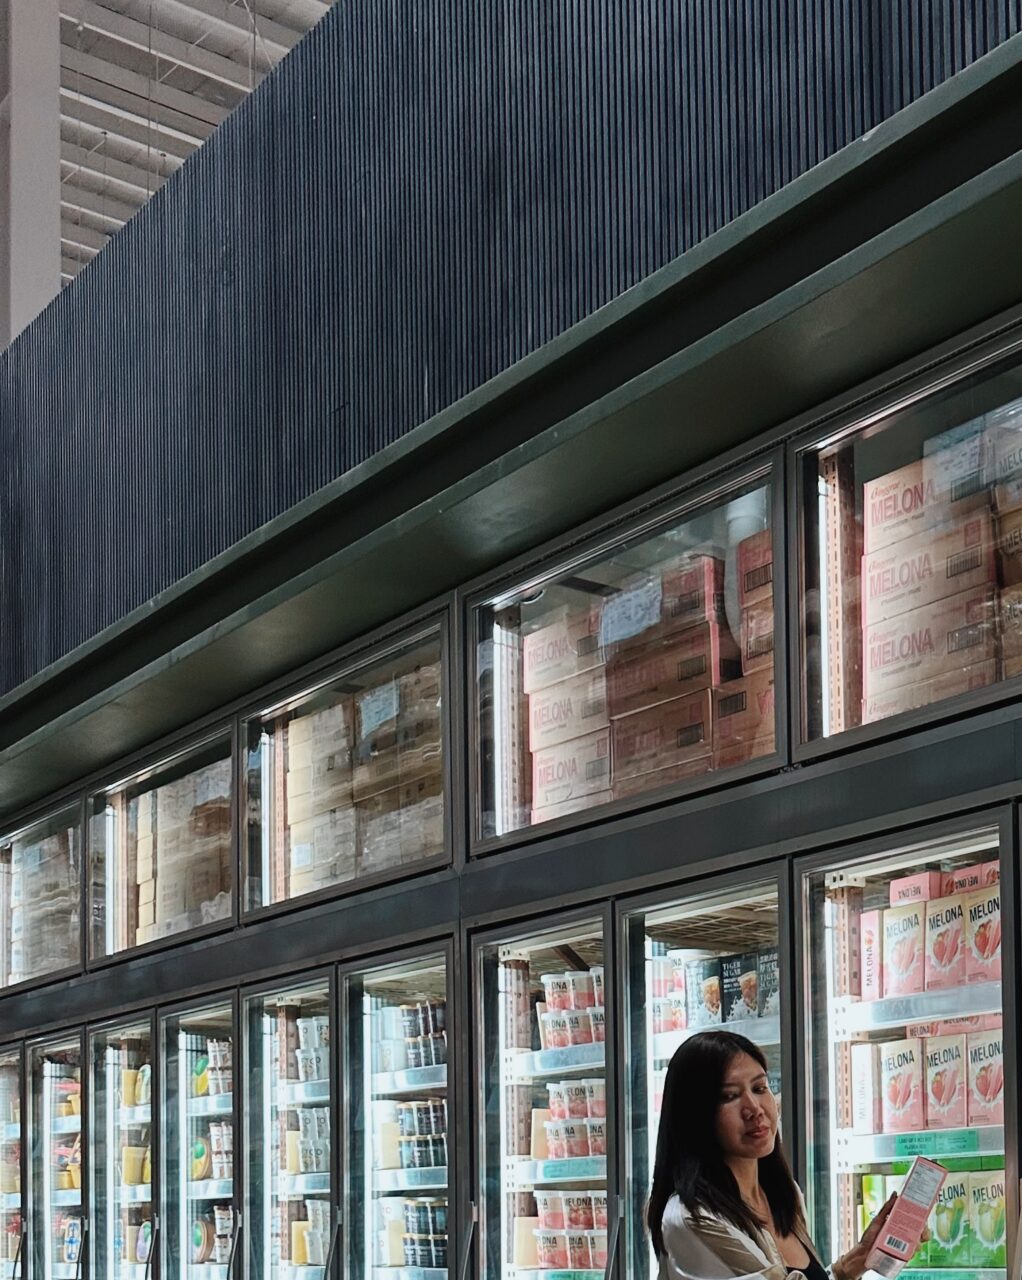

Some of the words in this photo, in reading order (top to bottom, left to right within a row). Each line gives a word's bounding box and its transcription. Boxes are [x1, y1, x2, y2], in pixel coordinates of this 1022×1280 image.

[871, 479, 934, 527] MELONA
[870, 554, 933, 596] MELONA
[871, 628, 934, 672] MELONA
[886, 914, 920, 937] MELONA
[929, 905, 964, 930] MELONA
[927, 1045, 961, 1067] MELONA
